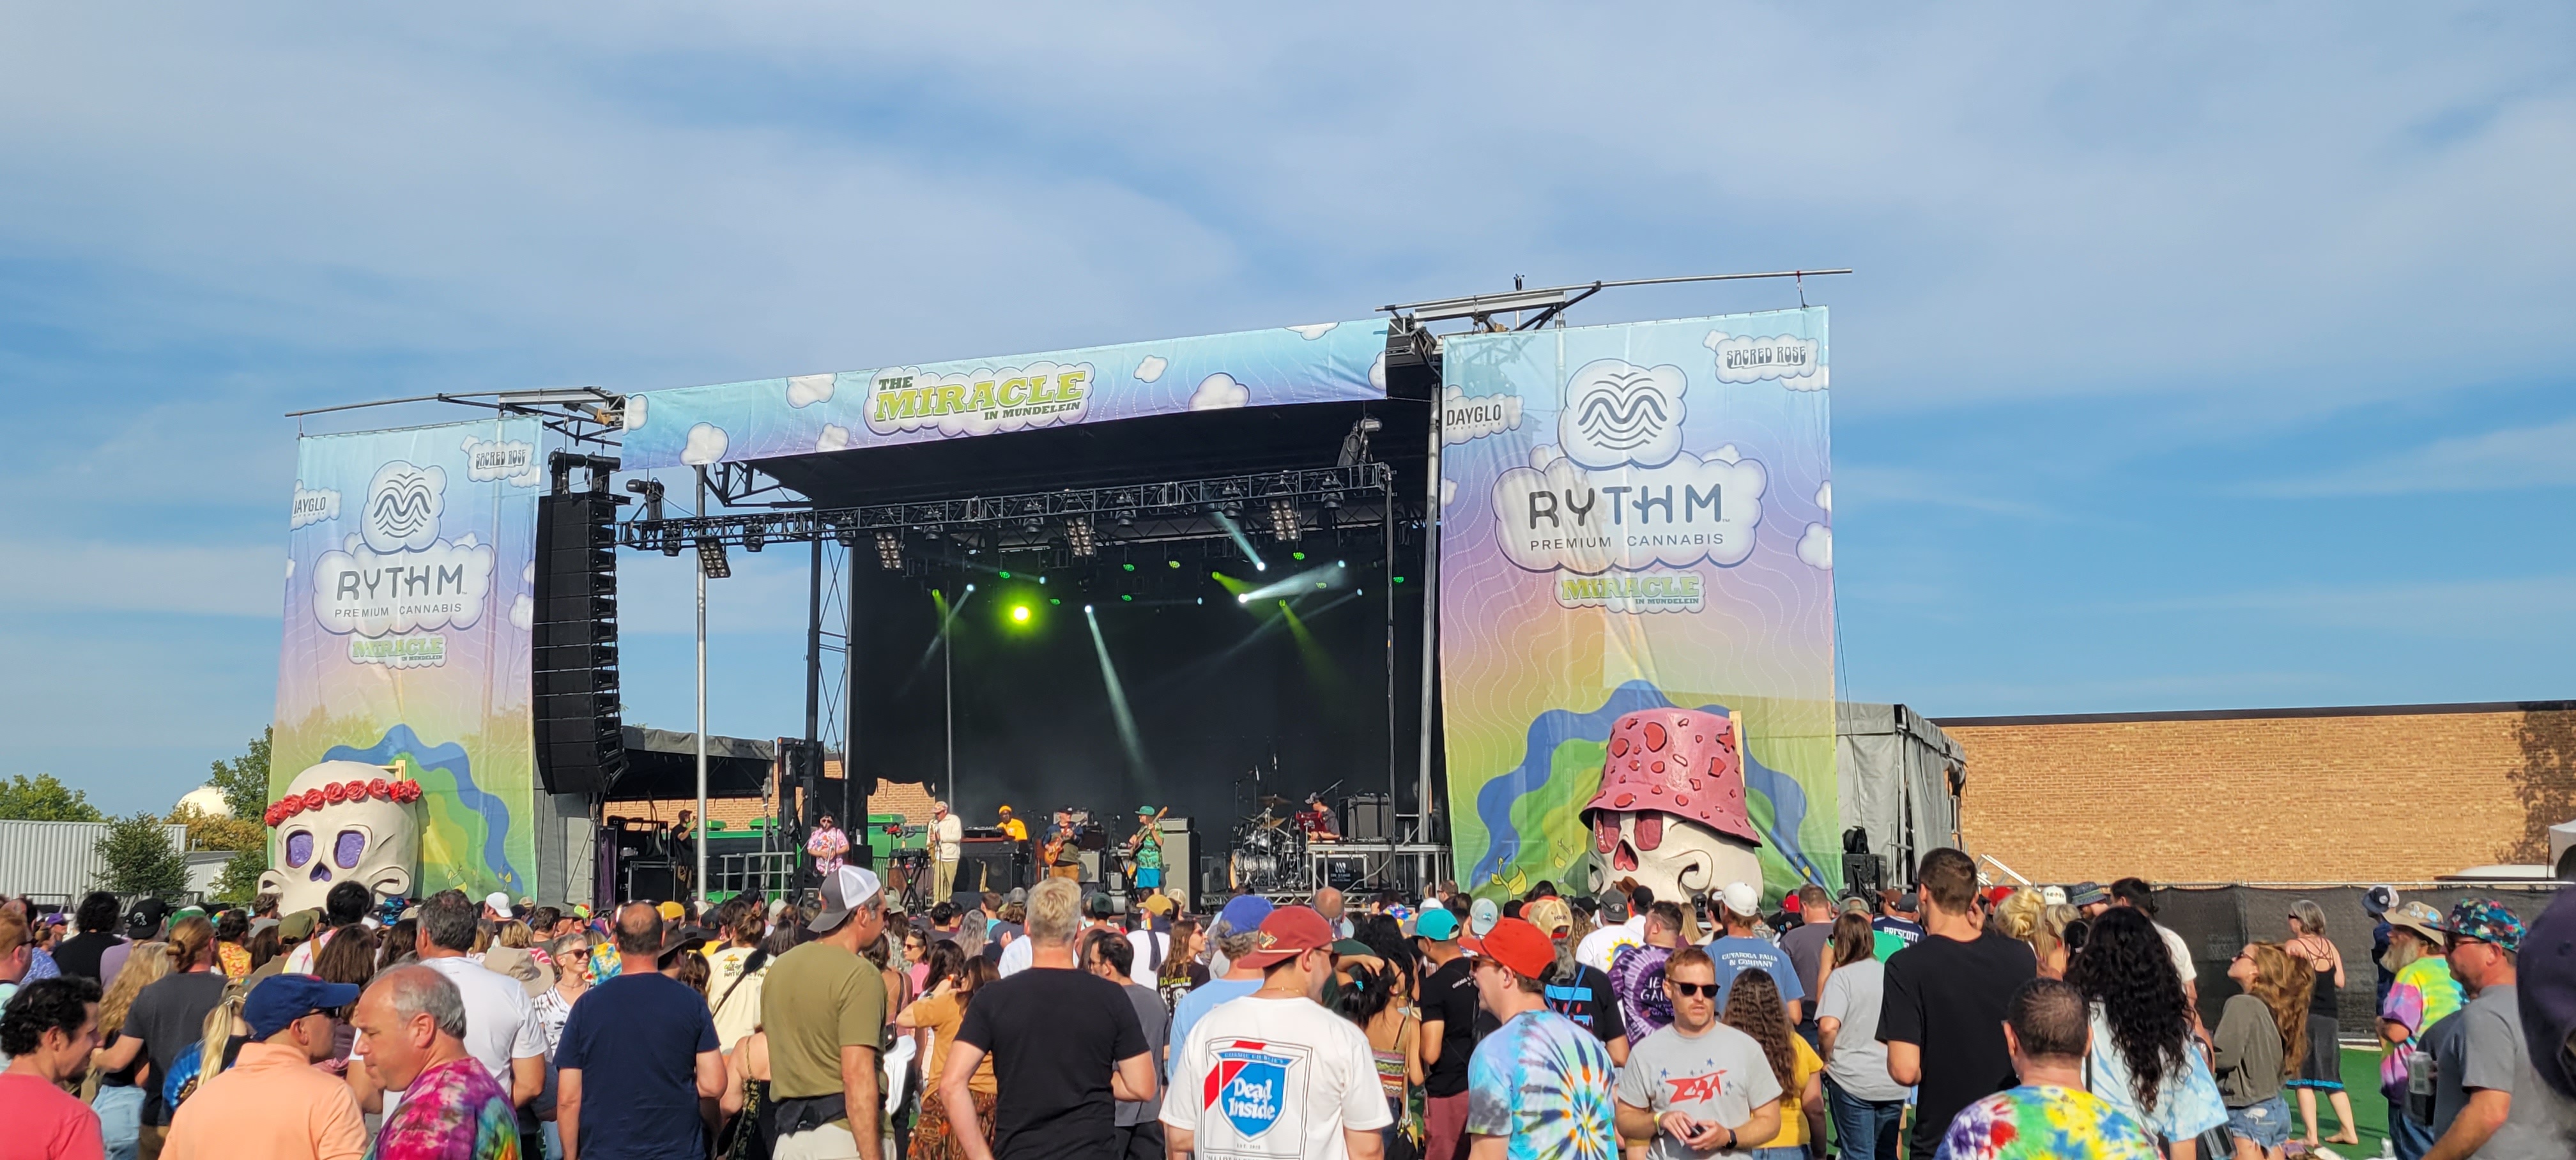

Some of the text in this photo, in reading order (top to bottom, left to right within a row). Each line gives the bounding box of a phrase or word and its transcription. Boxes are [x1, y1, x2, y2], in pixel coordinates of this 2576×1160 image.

[1727, 346, 1805, 369] SACRED ROSE
[878, 376, 913, 391] THE
[874, 370, 1085, 422] MIRACLE
[984, 402, 1081, 420] IN MUNDELEIN
[1446, 404, 1501, 426] DAYGLO
[476, 449, 526, 469] SACRED ROSE
[1529, 483, 1721, 530] RYTHM
[1531, 533, 1724, 551] PREMIUM CANNABIS
[337, 563, 463, 601] RYTHM
[1561, 576, 1699, 600] MIRACLE
[335, 603, 462, 618] PREMIUM CANNABIS
[353, 637, 443, 658] MIRACLE
[1883, 926, 1919, 943] PRESCOTT
[1738, 959, 1773, 968] COMPANY
[1234, 1077, 1273, 1103] Dead
[1228, 1097, 1275, 1120] Inside
